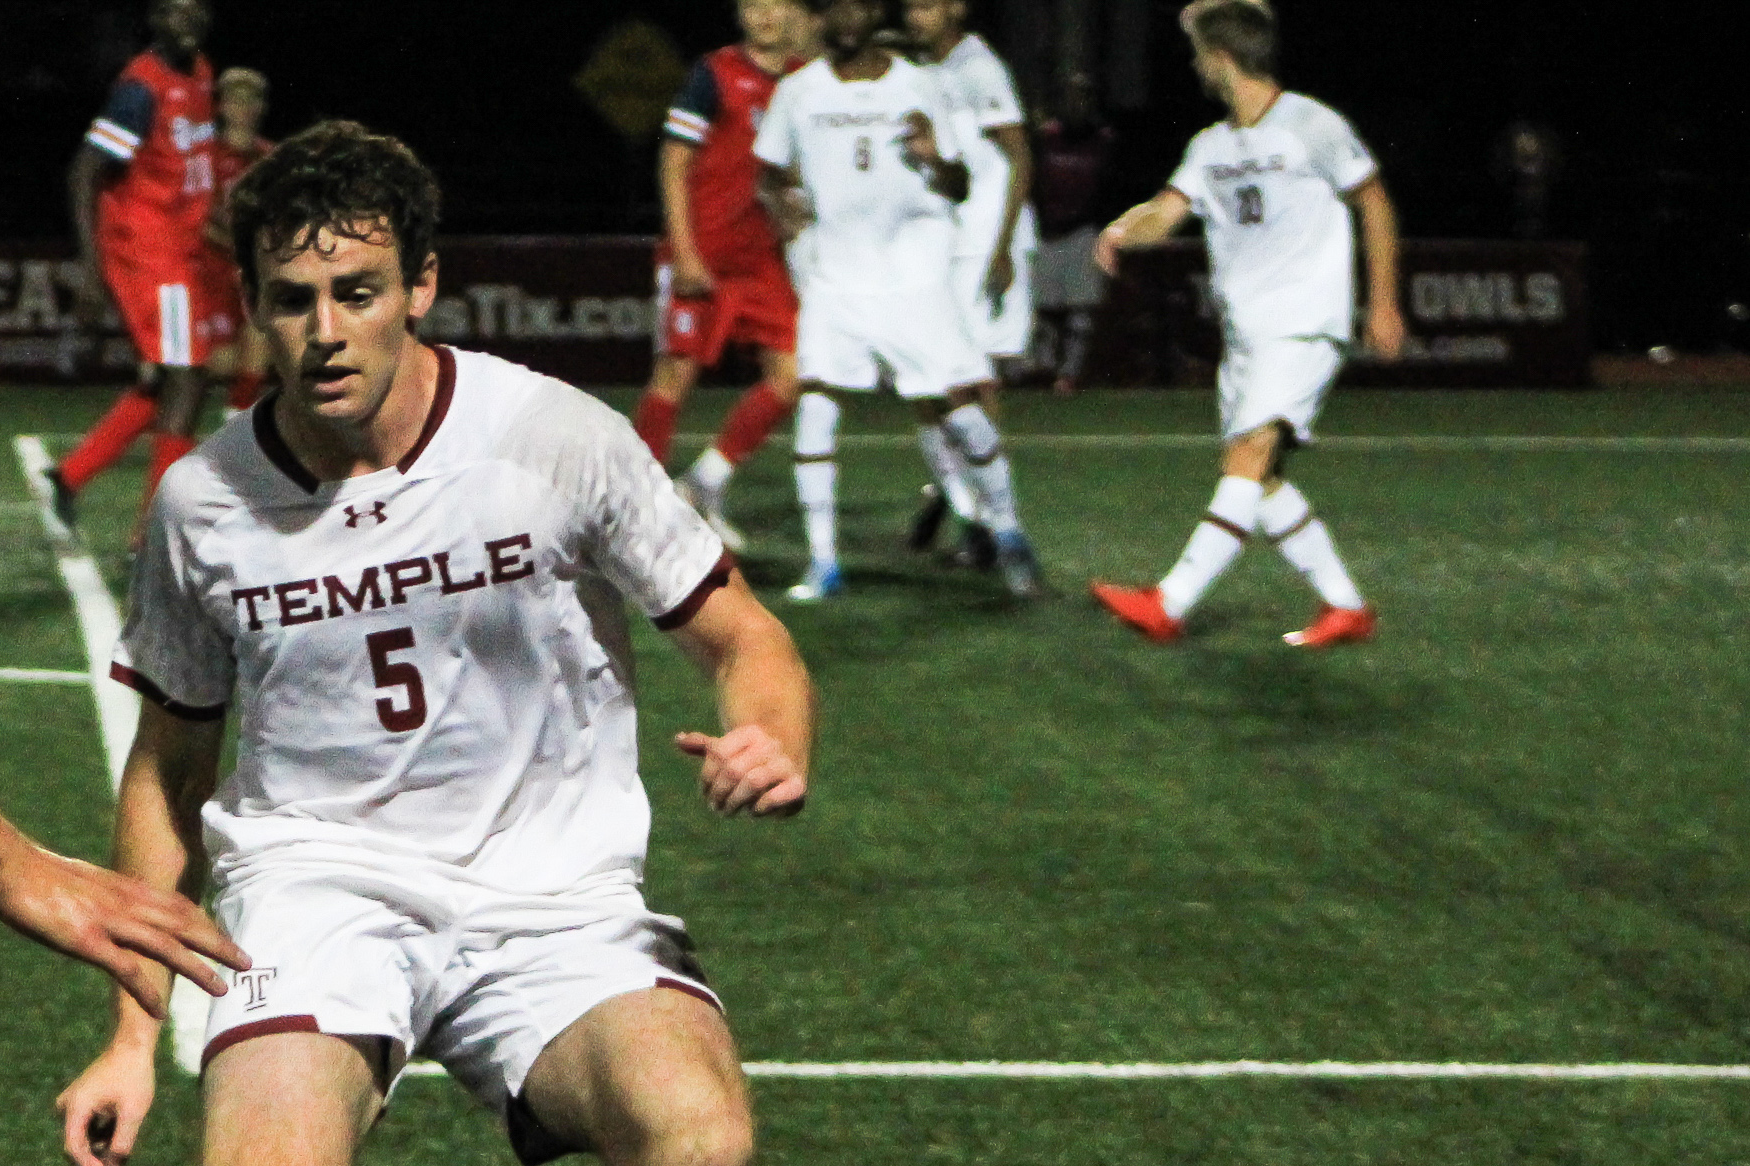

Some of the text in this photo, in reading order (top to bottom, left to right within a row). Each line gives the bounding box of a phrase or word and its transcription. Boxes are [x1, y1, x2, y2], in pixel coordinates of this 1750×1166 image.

[1411, 272, 1565, 323] OWLS
[231, 533, 535, 631] TEMPLE
[365, 626, 428, 733] 5
[233, 966, 277, 1012] T
